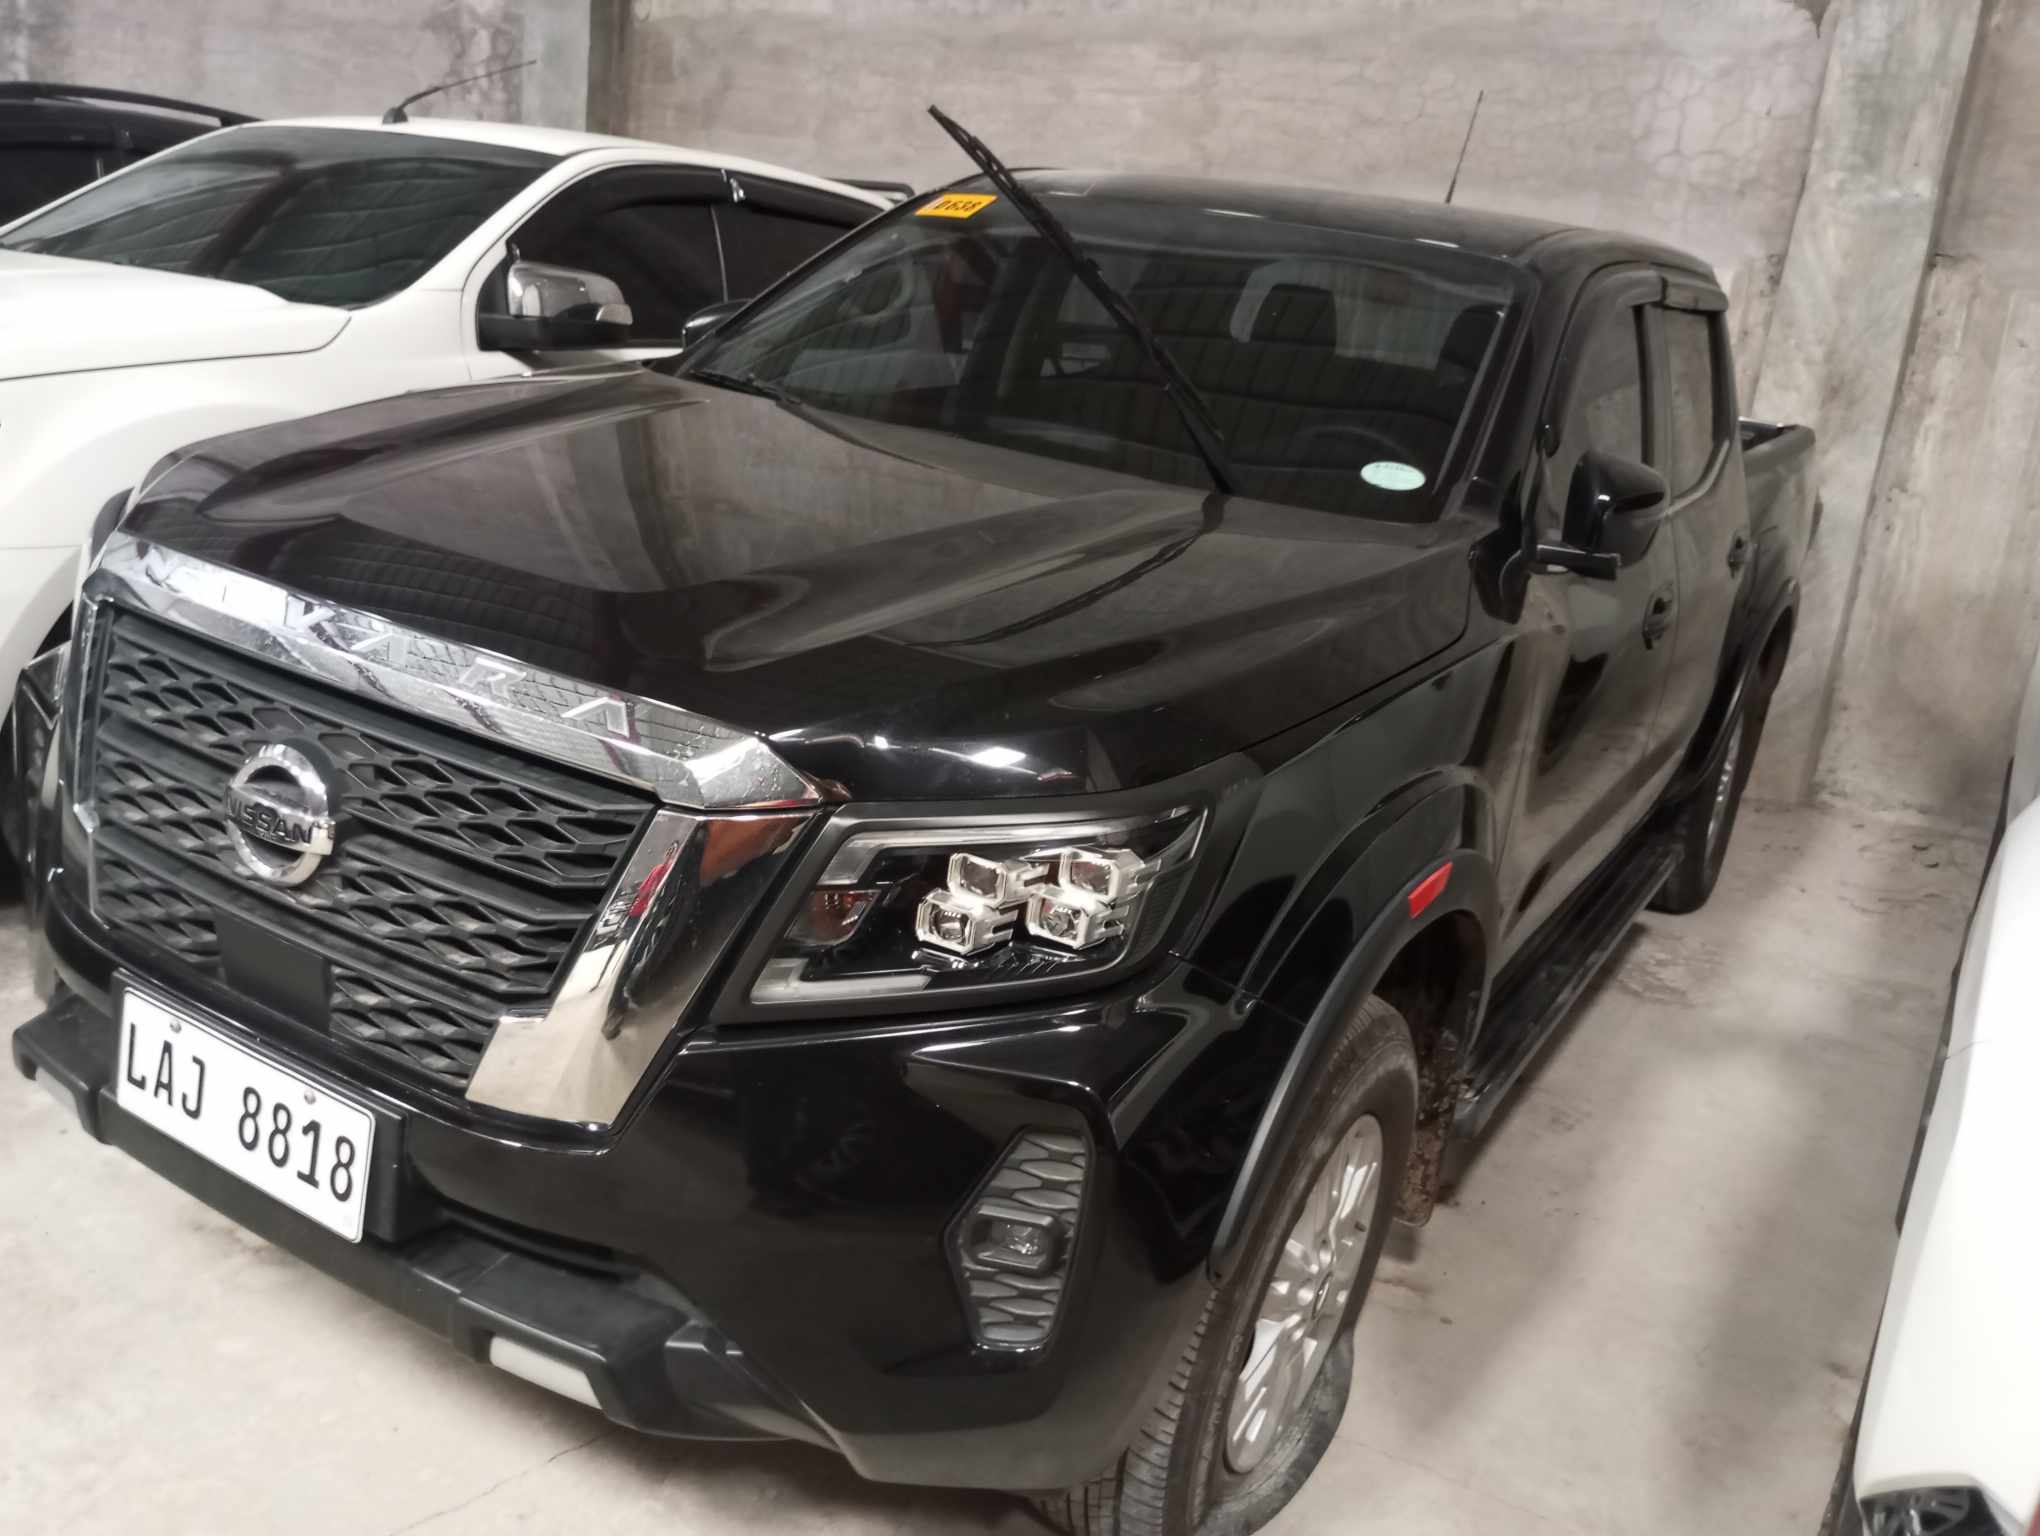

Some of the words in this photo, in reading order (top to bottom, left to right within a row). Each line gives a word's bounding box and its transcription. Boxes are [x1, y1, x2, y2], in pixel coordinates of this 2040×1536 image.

[136, 546, 630, 737] NVARA
[225, 786, 319, 844] NISSAN
[126, 1021, 206, 1120] LAJ
[238, 1085, 355, 1202] 8818
